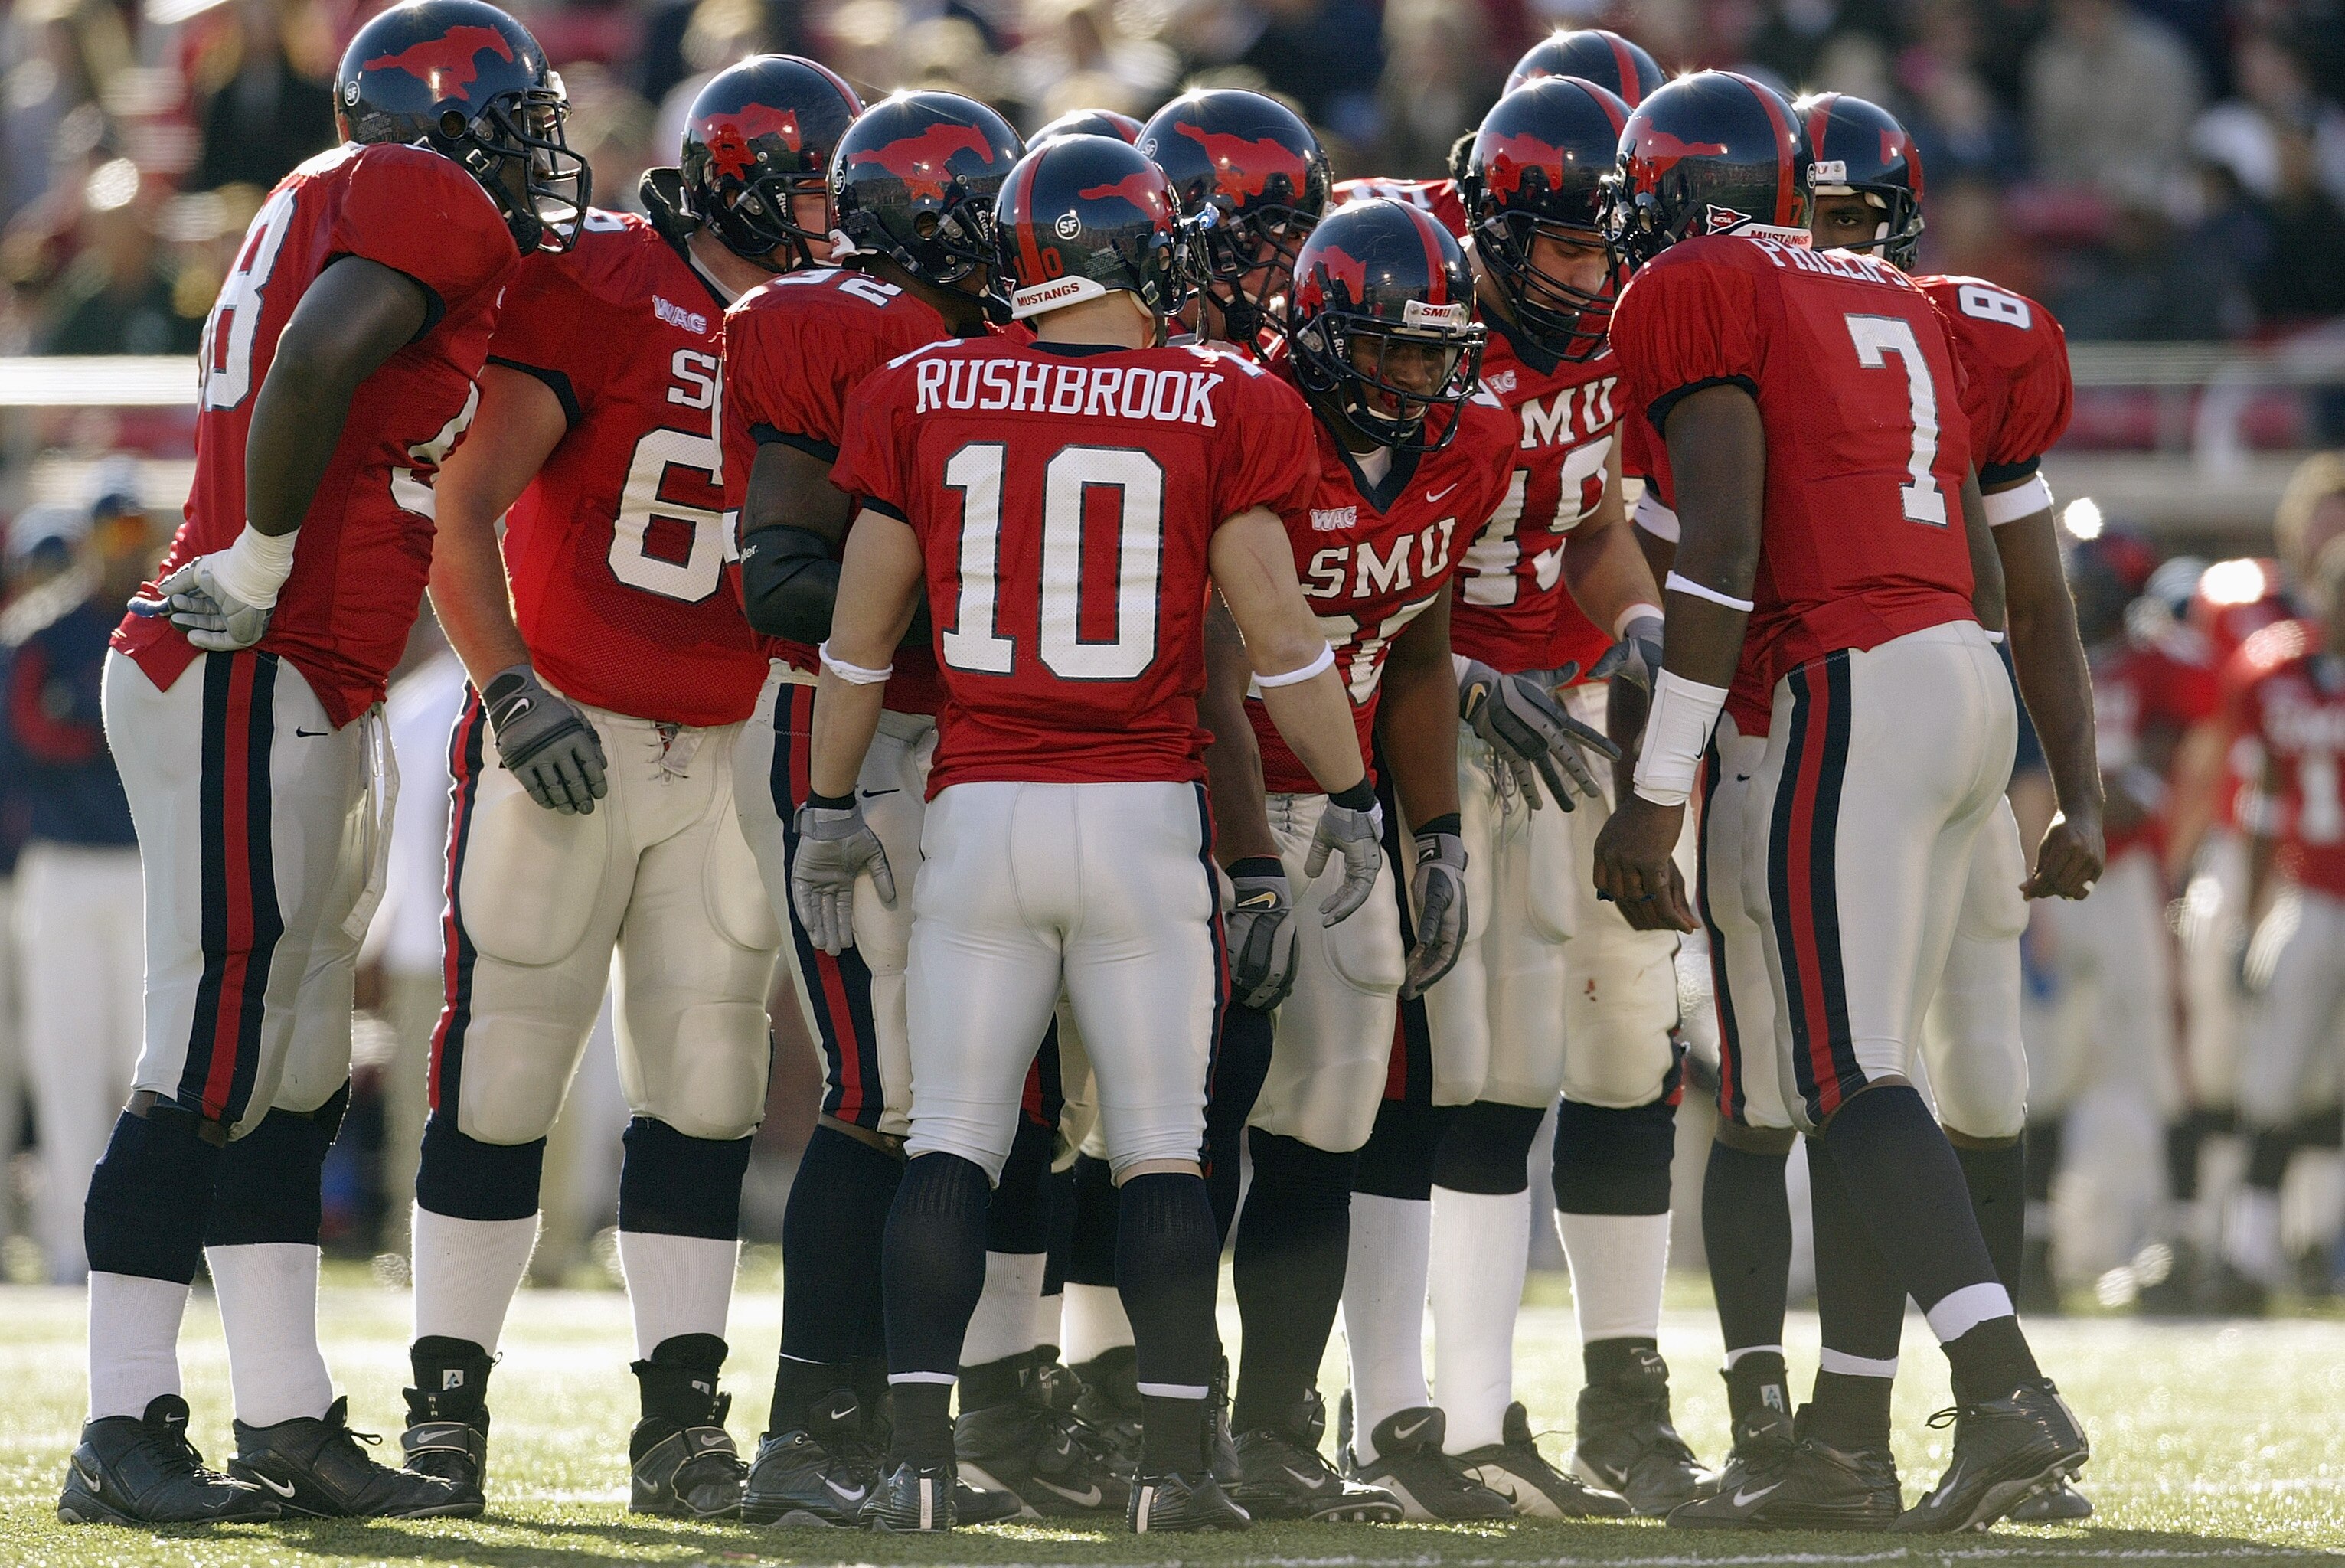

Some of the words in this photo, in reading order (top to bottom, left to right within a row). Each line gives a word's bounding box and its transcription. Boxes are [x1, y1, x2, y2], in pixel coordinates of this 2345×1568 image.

[1059, 219, 1077, 234] SF
[1750, 230, 1809, 246] MUSTANGS
[1017, 283, 1081, 306] MUSTANGS
[1421, 307, 1452, 318] SMU
[916, 358, 1223, 428] RUSHBROOK
[1845, 313, 1948, 526] 7
[1309, 506, 1357, 531] WAC
[942, 441, 1167, 681] 10
[1301, 516, 1455, 599] SMU
